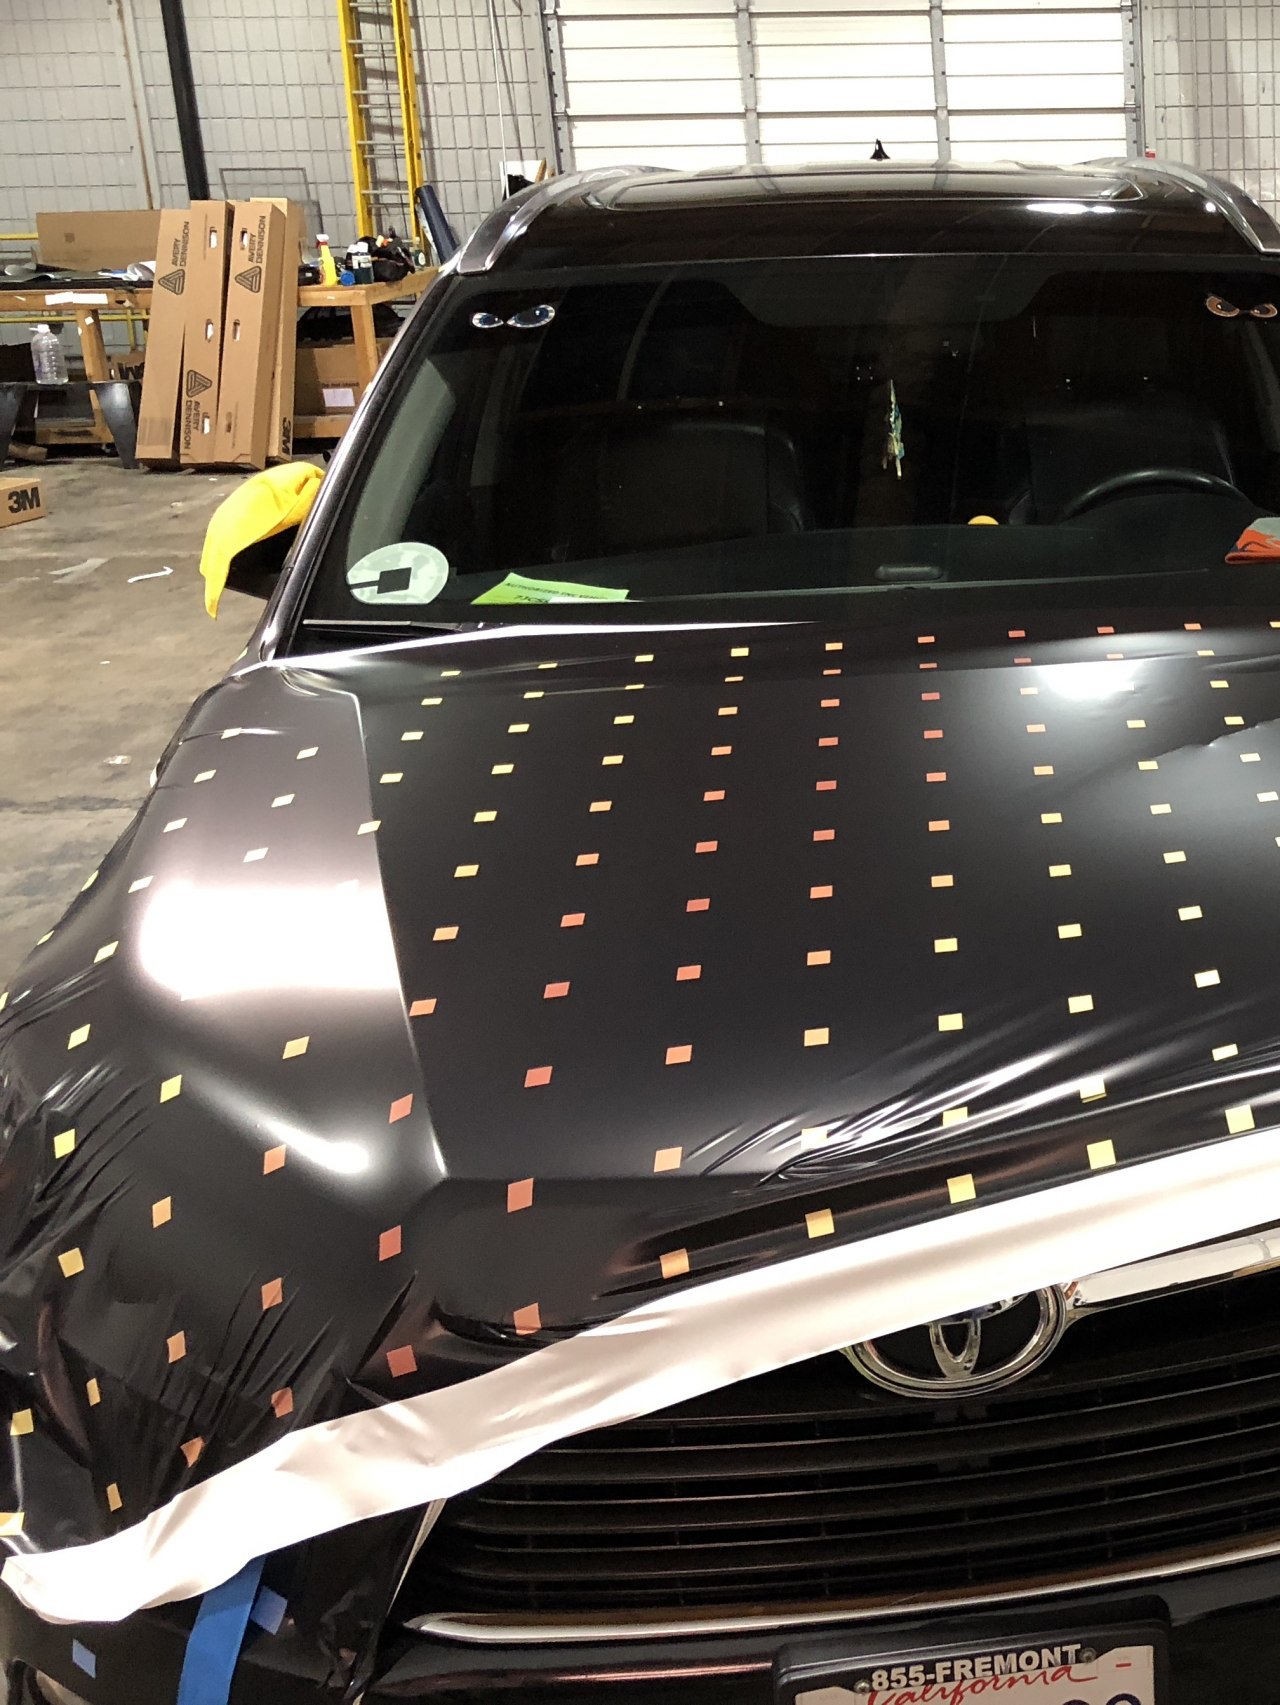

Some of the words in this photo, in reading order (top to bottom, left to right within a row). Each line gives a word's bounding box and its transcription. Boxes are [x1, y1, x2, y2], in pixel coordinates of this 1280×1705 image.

[172, 238, 181, 266] AVERY
[179, 221, 190, 267] DENNISON
[248, 233, 256, 262] AVERY
[255, 215, 266, 264] DENNISON
[184, 399, 193, 450] DENNISON
[193, 401, 201, 431] AVERY
[282, 416, 291, 455] 3M
[8, 486, 41, 514] 3M
[871, 1643, 1082, 1691] 855-FREMONT
